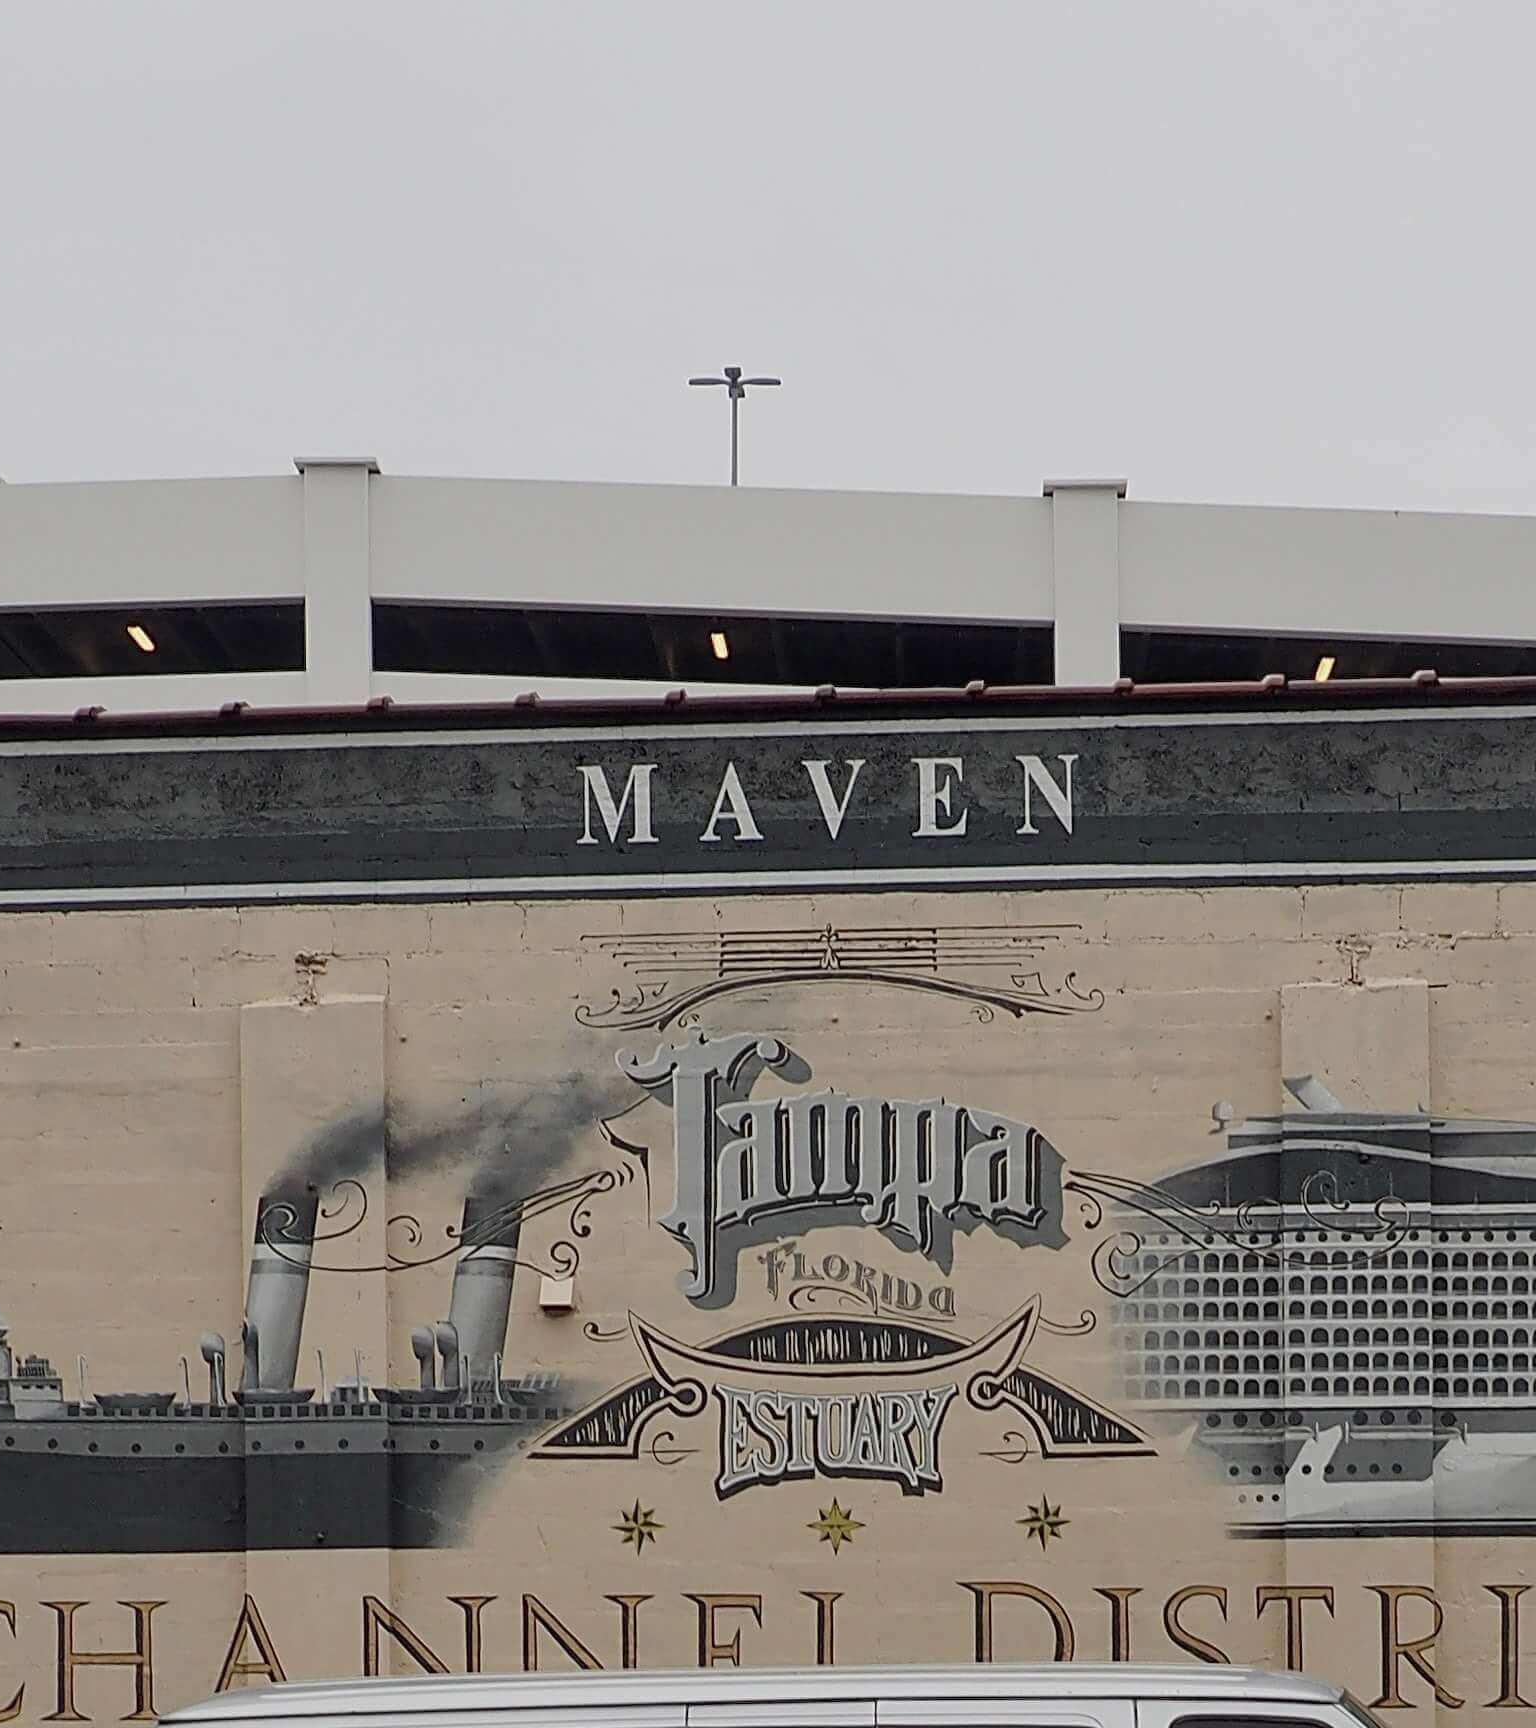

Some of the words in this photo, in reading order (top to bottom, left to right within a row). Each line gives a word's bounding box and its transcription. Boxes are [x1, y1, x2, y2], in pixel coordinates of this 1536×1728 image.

[575, 753, 1079, 845] MAVEN
[615, 1027, 1068, 1309] Tampa
[713, 1383, 958, 1498] ESTUARY
